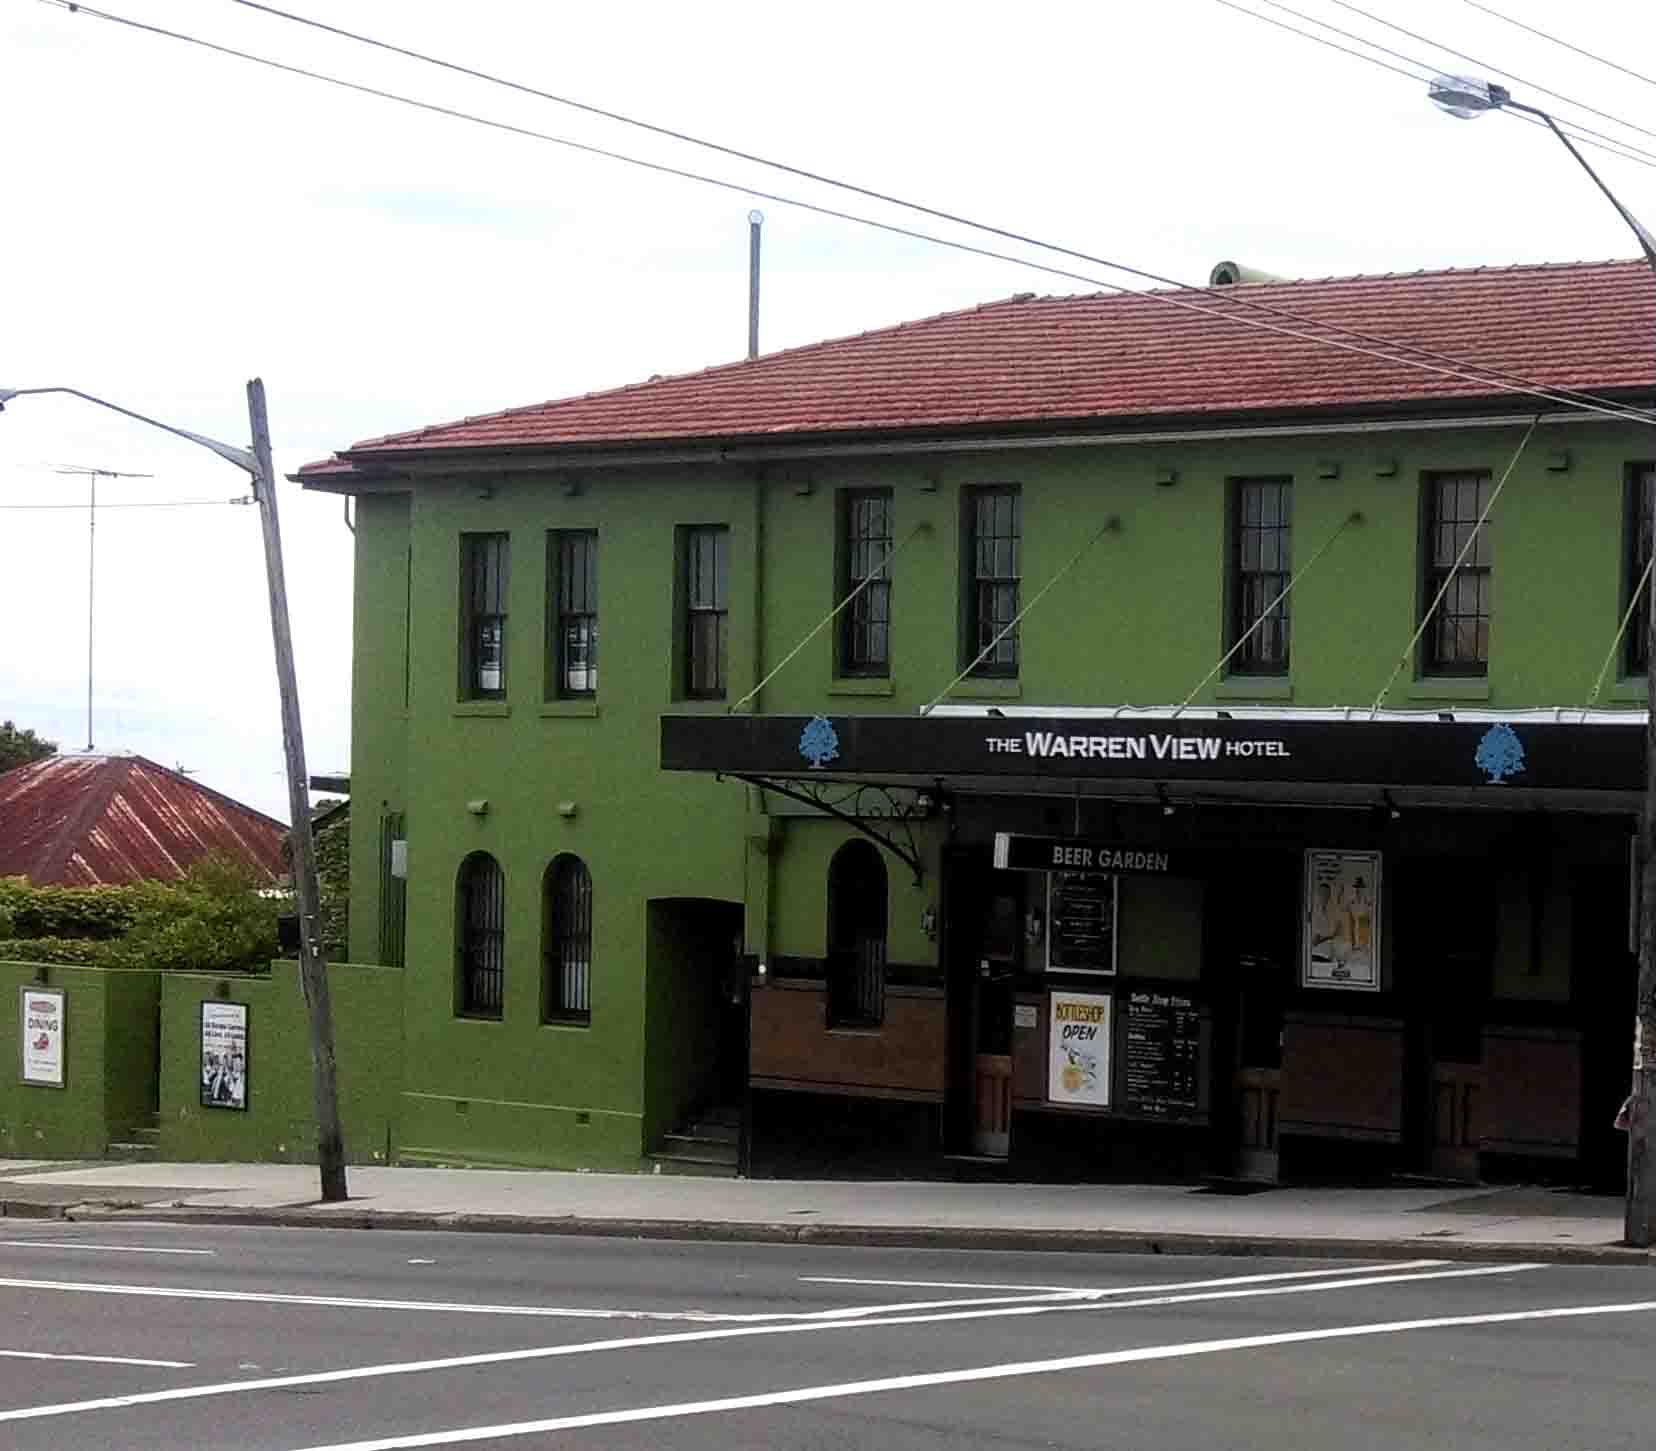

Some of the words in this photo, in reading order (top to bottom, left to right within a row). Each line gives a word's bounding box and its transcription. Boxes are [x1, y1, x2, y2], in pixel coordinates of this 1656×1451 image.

[986, 737, 1022, 753] THE
[1025, 731, 1146, 759] WARREN
[1148, 734, 1222, 760] VIEW
[1225, 740, 1291, 757] HOTEL
[1053, 845, 1093, 866] BEER
[1099, 849, 1169, 871] GARDEN
[28, 1017, 58, 1032] DINING
[1062, 1024, 1098, 1041] OPEN
